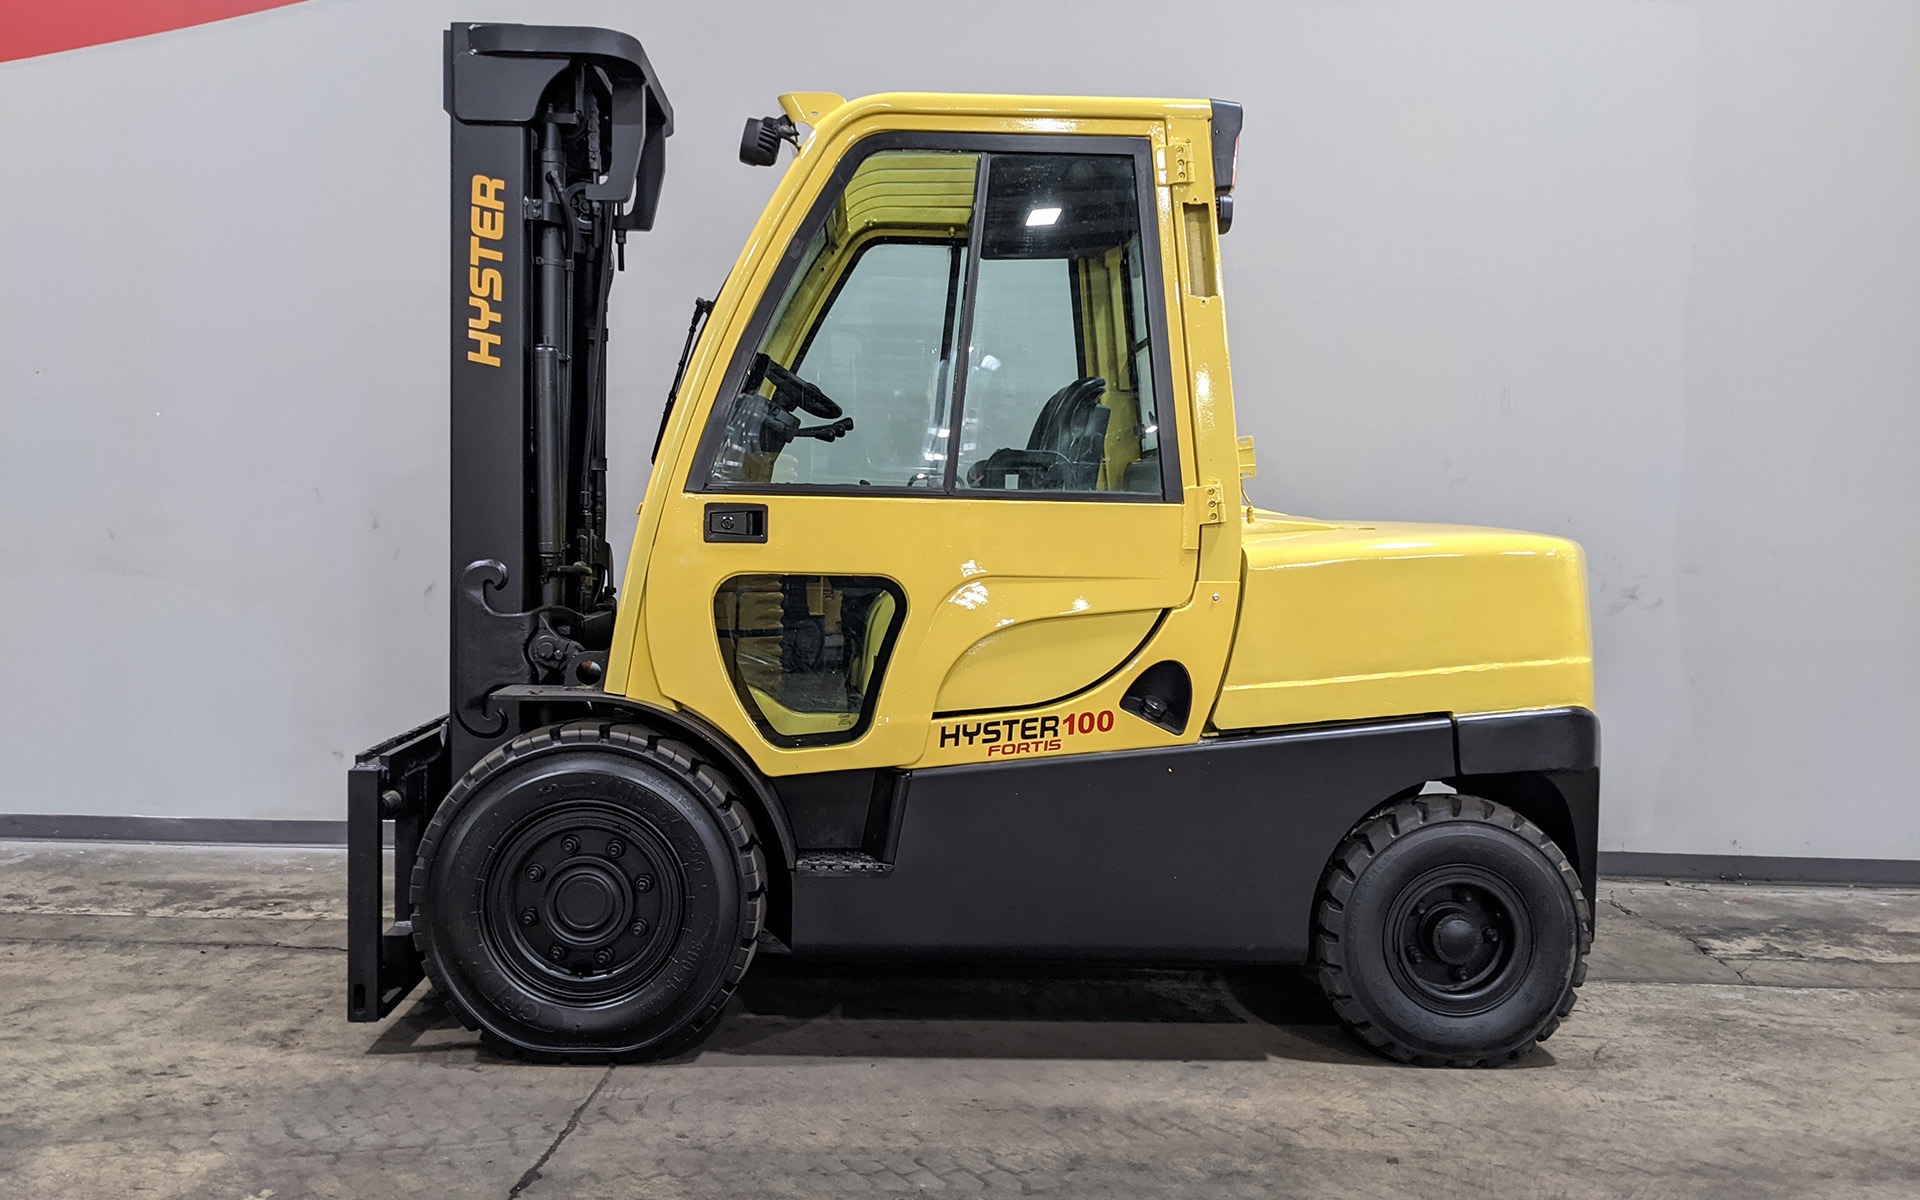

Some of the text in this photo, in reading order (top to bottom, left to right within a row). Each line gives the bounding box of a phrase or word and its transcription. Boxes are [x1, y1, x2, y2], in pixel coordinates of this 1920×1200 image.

[467, 174, 505, 368] HYSTER
[939, 710, 1114, 748] HYSTER 100
[987, 739, 1061, 757] FORTIS
